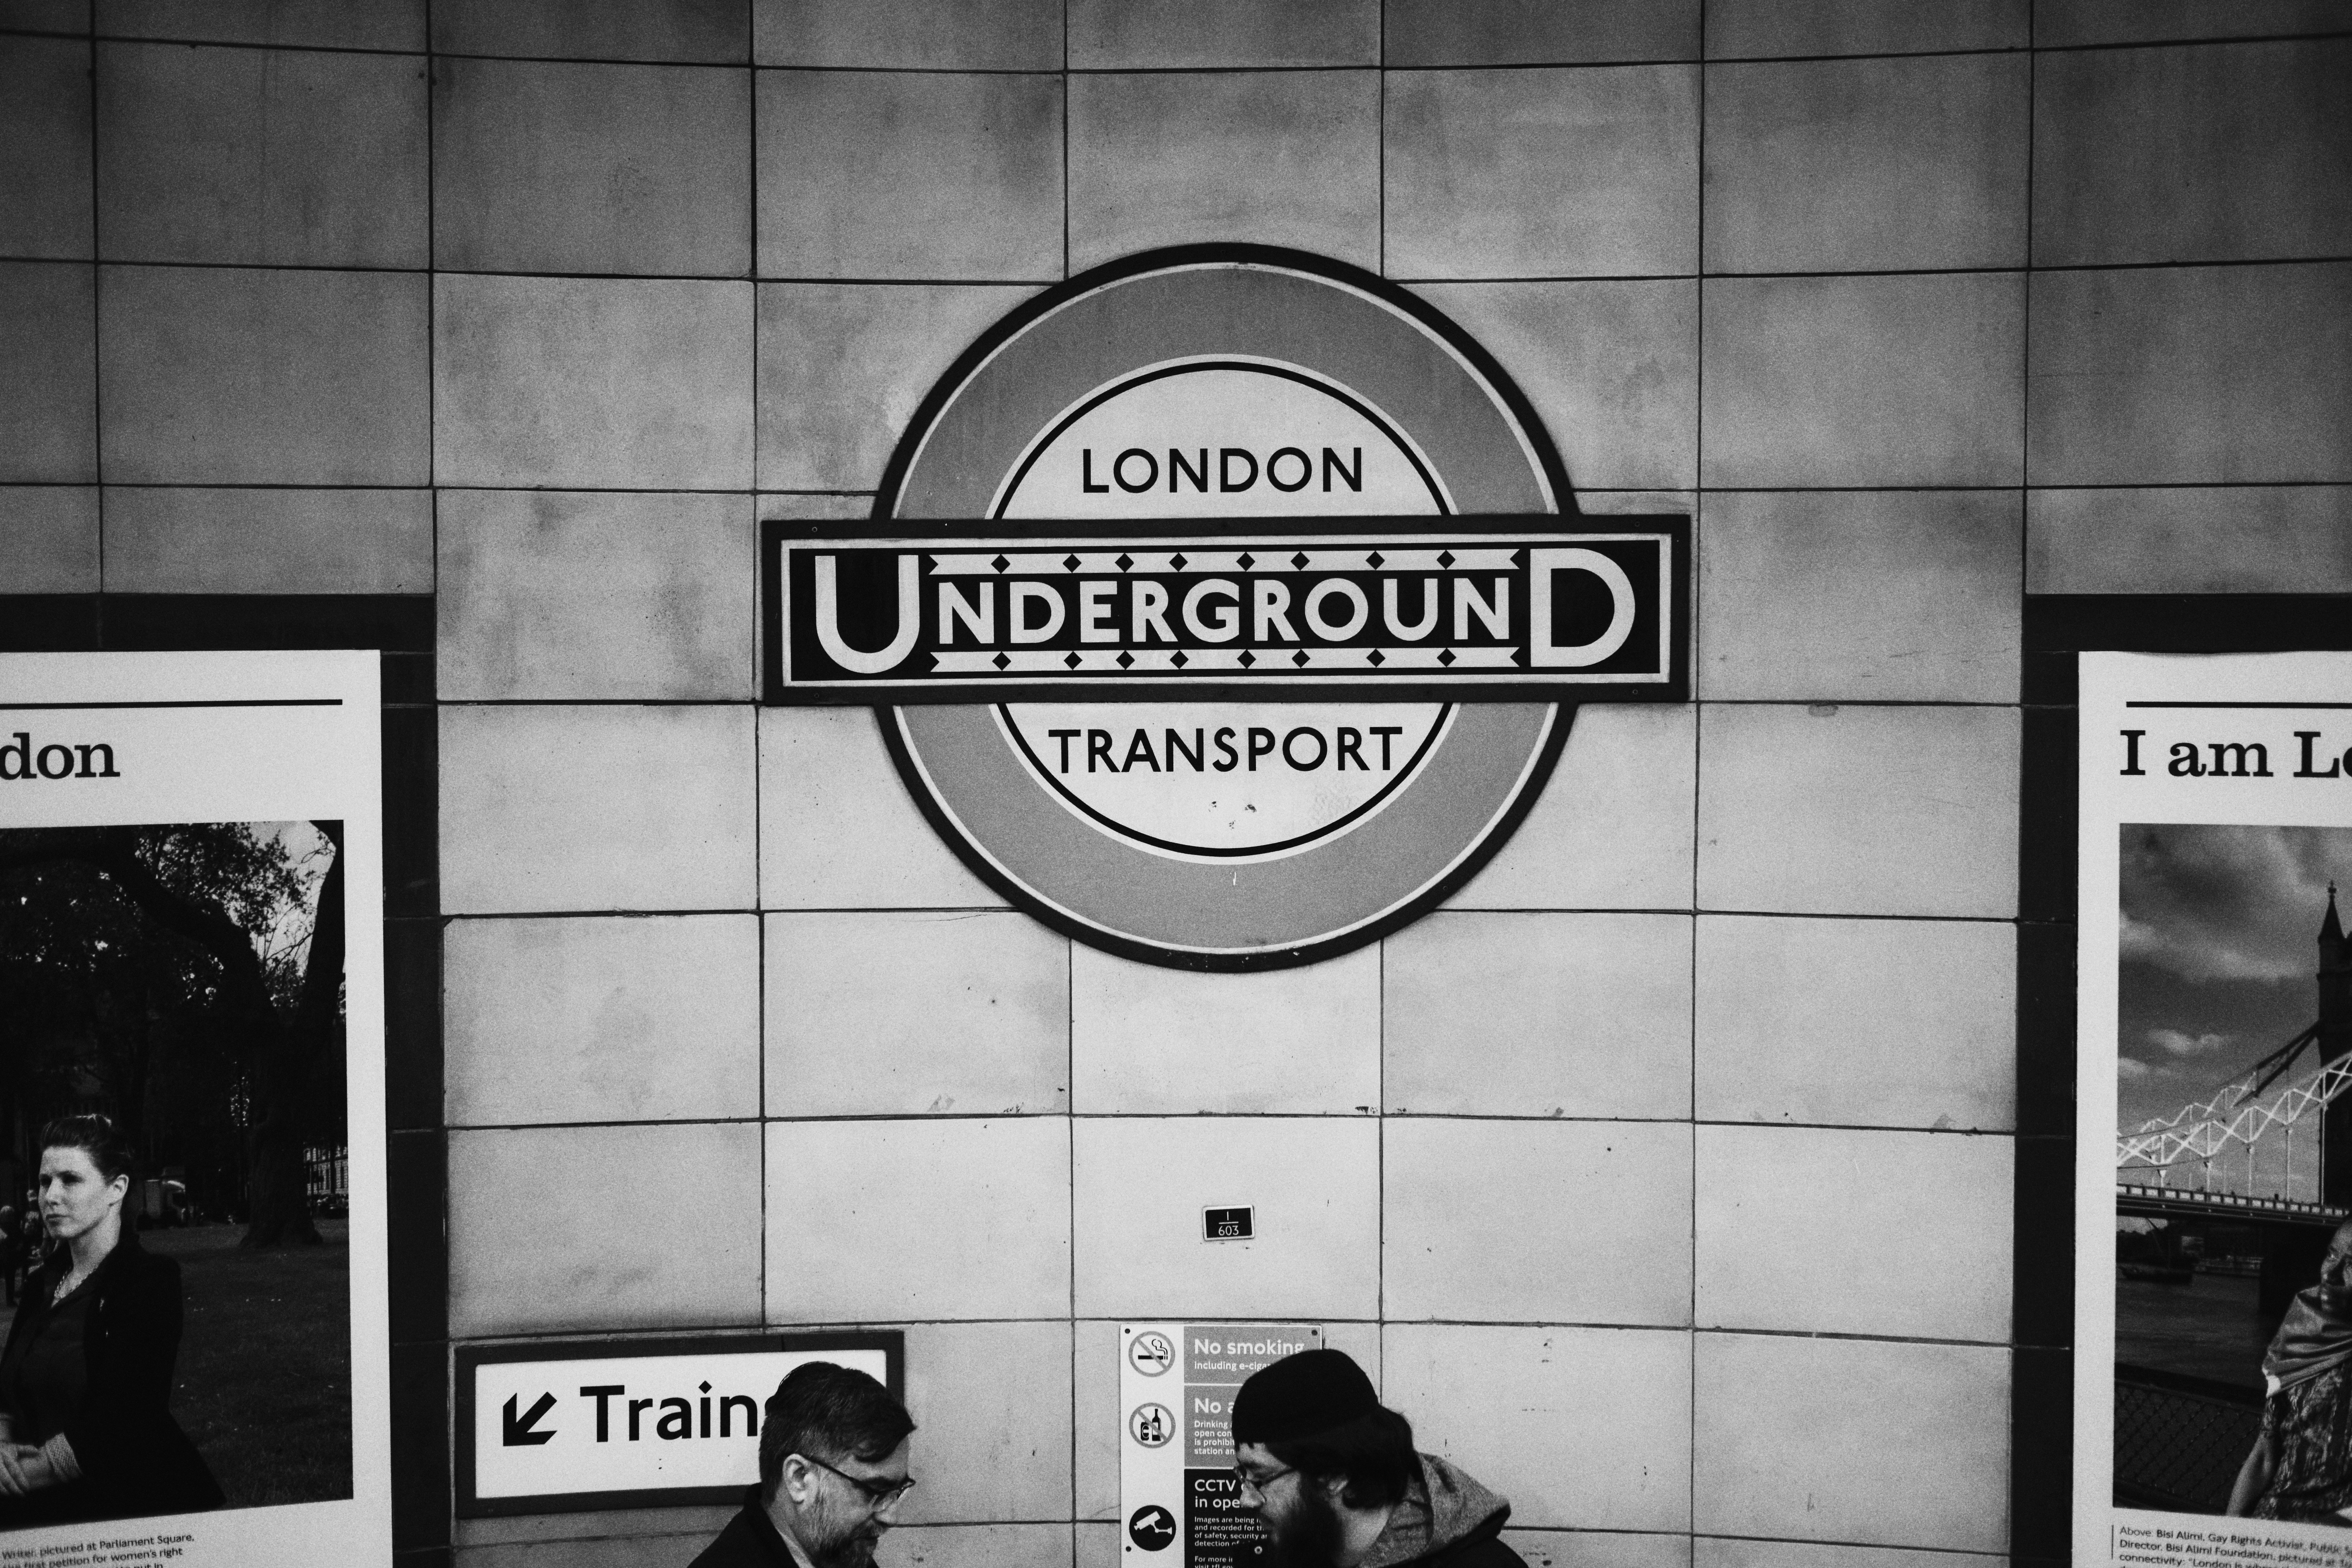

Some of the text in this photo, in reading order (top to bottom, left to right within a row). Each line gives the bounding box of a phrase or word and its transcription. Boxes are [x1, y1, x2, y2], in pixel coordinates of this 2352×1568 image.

[1083, 447, 1363, 493] LONDON
[815, 547, 1635, 674] UNDERGROUND
[1048, 726, 1403, 775] TRANSPORT
[2120, 730, 2352, 778] I am L
[1218, 1225, 1239, 1236] 603
[1194, 1338, 1305, 1355] No smoking
[1194, 1361, 1237, 1371] including
[580, 1380, 773, 1443] Train
[1195, 1398, 1221, 1413] No
[1194, 1420, 1228, 1430] Drinking
[1204, 1438, 1234, 1447] prohibit
[1195, 1479, 1236, 1492] CCTV
[1195, 1496, 1240, 1511] in ope
[86, 1542, 97, 1551] at
[100, 1537, 155, 1549] Parliament
[157, 1534, 194, 1545] Square,
[2157, 1530, 2173, 1538] Bisi
[2208, 1533, 2228, 1545] Gay
[2231, 1535, 2262, 1546] Rights
[93, 1554, 108, 1563] for
[159, 1547, 183, 1559] right
[2166, 1544, 2183, 1553] Bisi
[2186, 1545, 2212, 1555] Alimi
